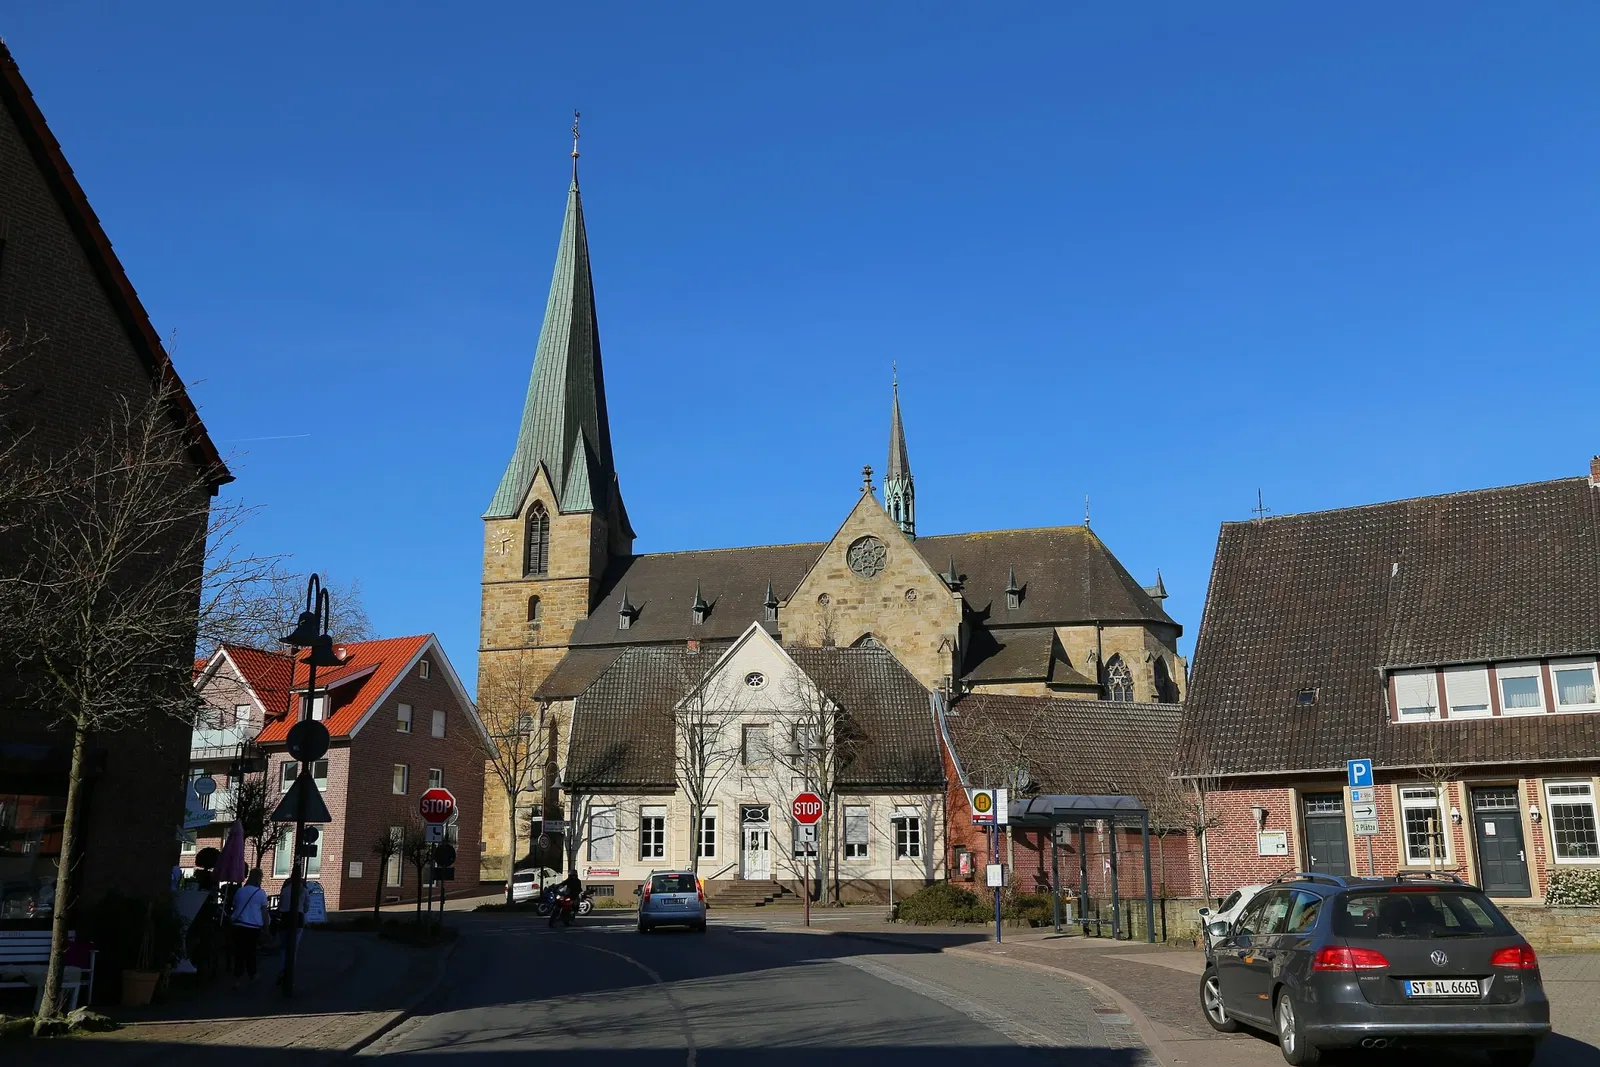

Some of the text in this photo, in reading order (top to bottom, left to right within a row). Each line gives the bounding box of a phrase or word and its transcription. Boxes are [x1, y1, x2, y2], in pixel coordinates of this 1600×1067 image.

[1353, 763, 1366, 784] P
[421, 799, 452, 813] STOP
[794, 802, 820, 815] STOP
[978, 796, 987, 809] H
[1360, 823, 1376, 831] Plätze
[1412, 981, 1478, 994] ST AL 6665
